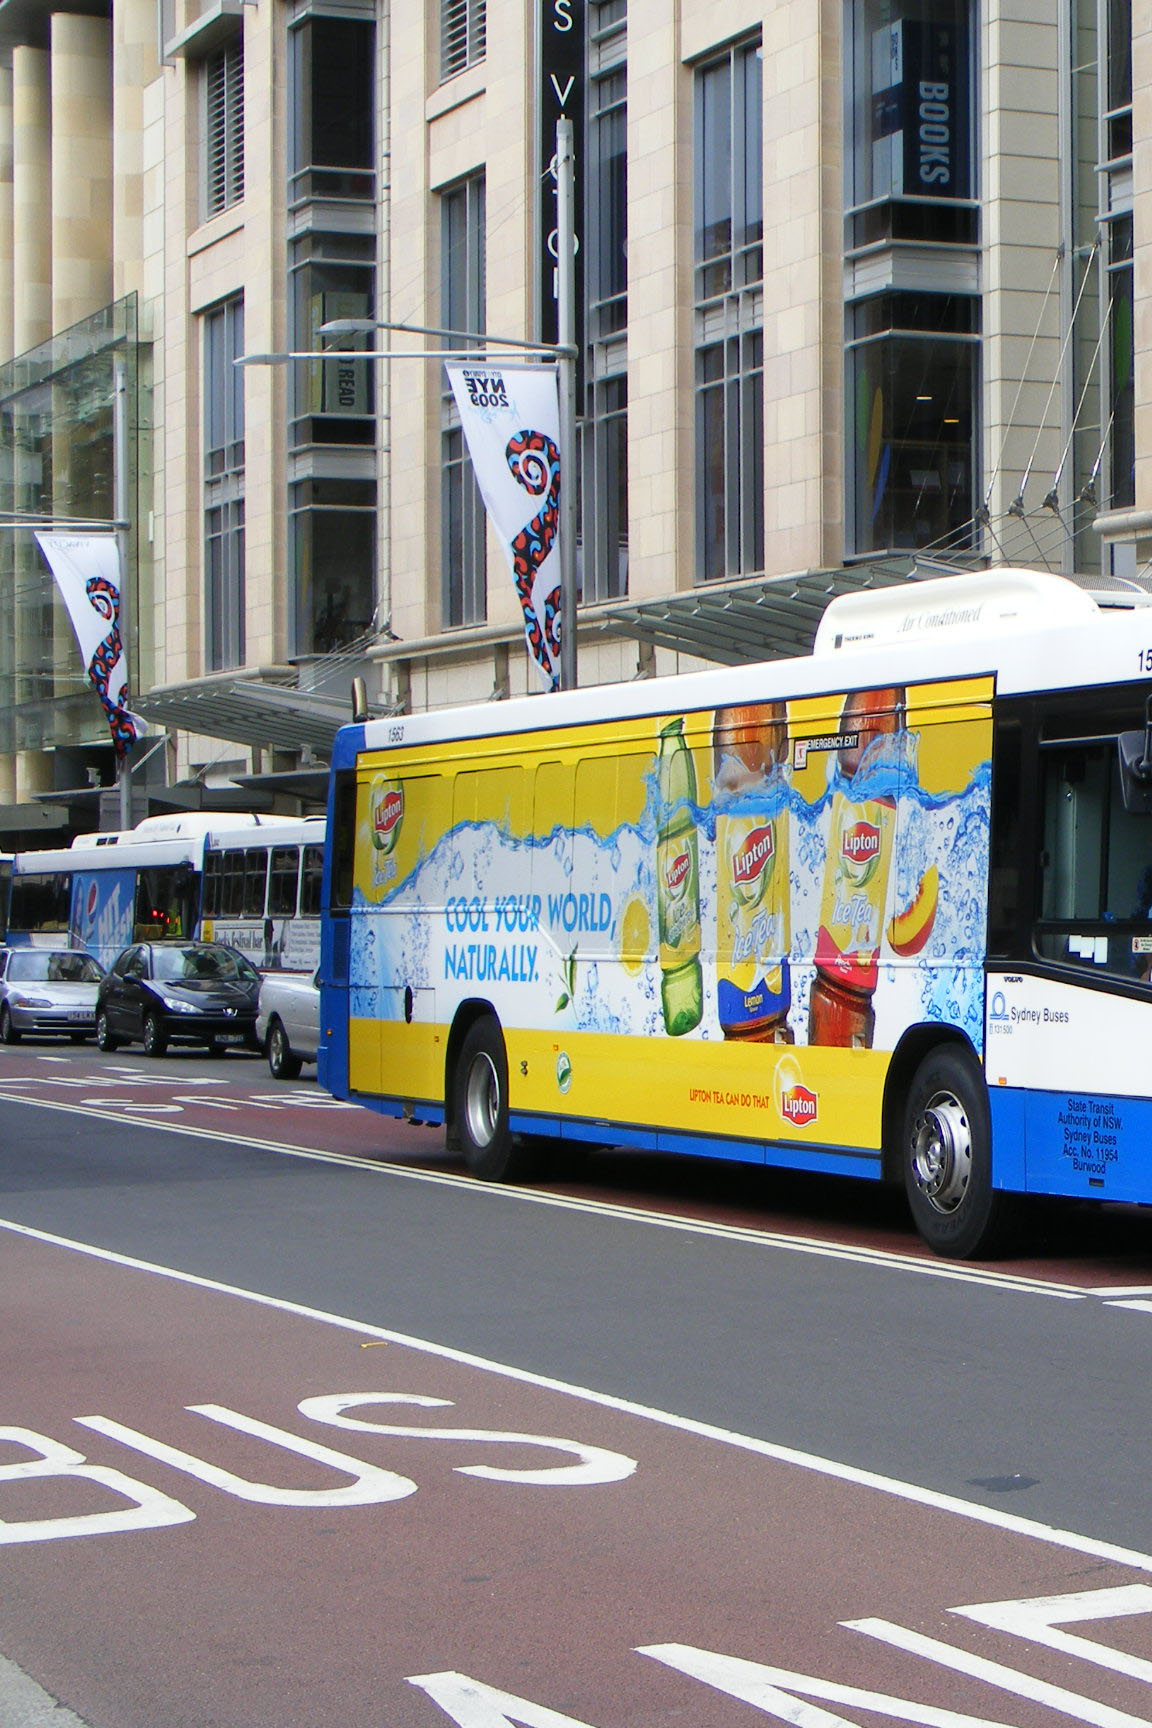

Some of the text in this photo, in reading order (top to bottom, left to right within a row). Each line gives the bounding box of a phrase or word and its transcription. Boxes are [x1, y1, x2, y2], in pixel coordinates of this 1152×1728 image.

[919, 81, 950, 184] BOOKS
[338, 368, 355, 407] READ
[388, 727, 404, 742] 1563
[808, 735, 858, 749] EMERGENCY EXIT
[376, 800, 400, 826] Lipton
[844, 833, 878, 856] Lipton
[735, 835, 771, 877] Lipton
[668, 858, 690, 884] Lipton
[445, 893, 617, 941] COOL YOUR WORLD,
[444, 944, 539, 982] NATURALLY.
[1011, 1006, 1069, 1025] Sydney Buses
[690, 1089, 769, 1108] LIPTON TEA CAN DO THAT
[783, 1095, 815, 1117] Lipton
[1067, 1098, 1114, 1115] State Transit
[1058, 1112, 1123, 1130] Authority of NSW.
[1064, 1127, 1117, 1145] Sydney Buses
[1063, 1144, 1118, 1161] Acc. No. 11954
[1073, 1158, 1105, 1174] Burwood
[0, 1391, 638, 1546] BUS
